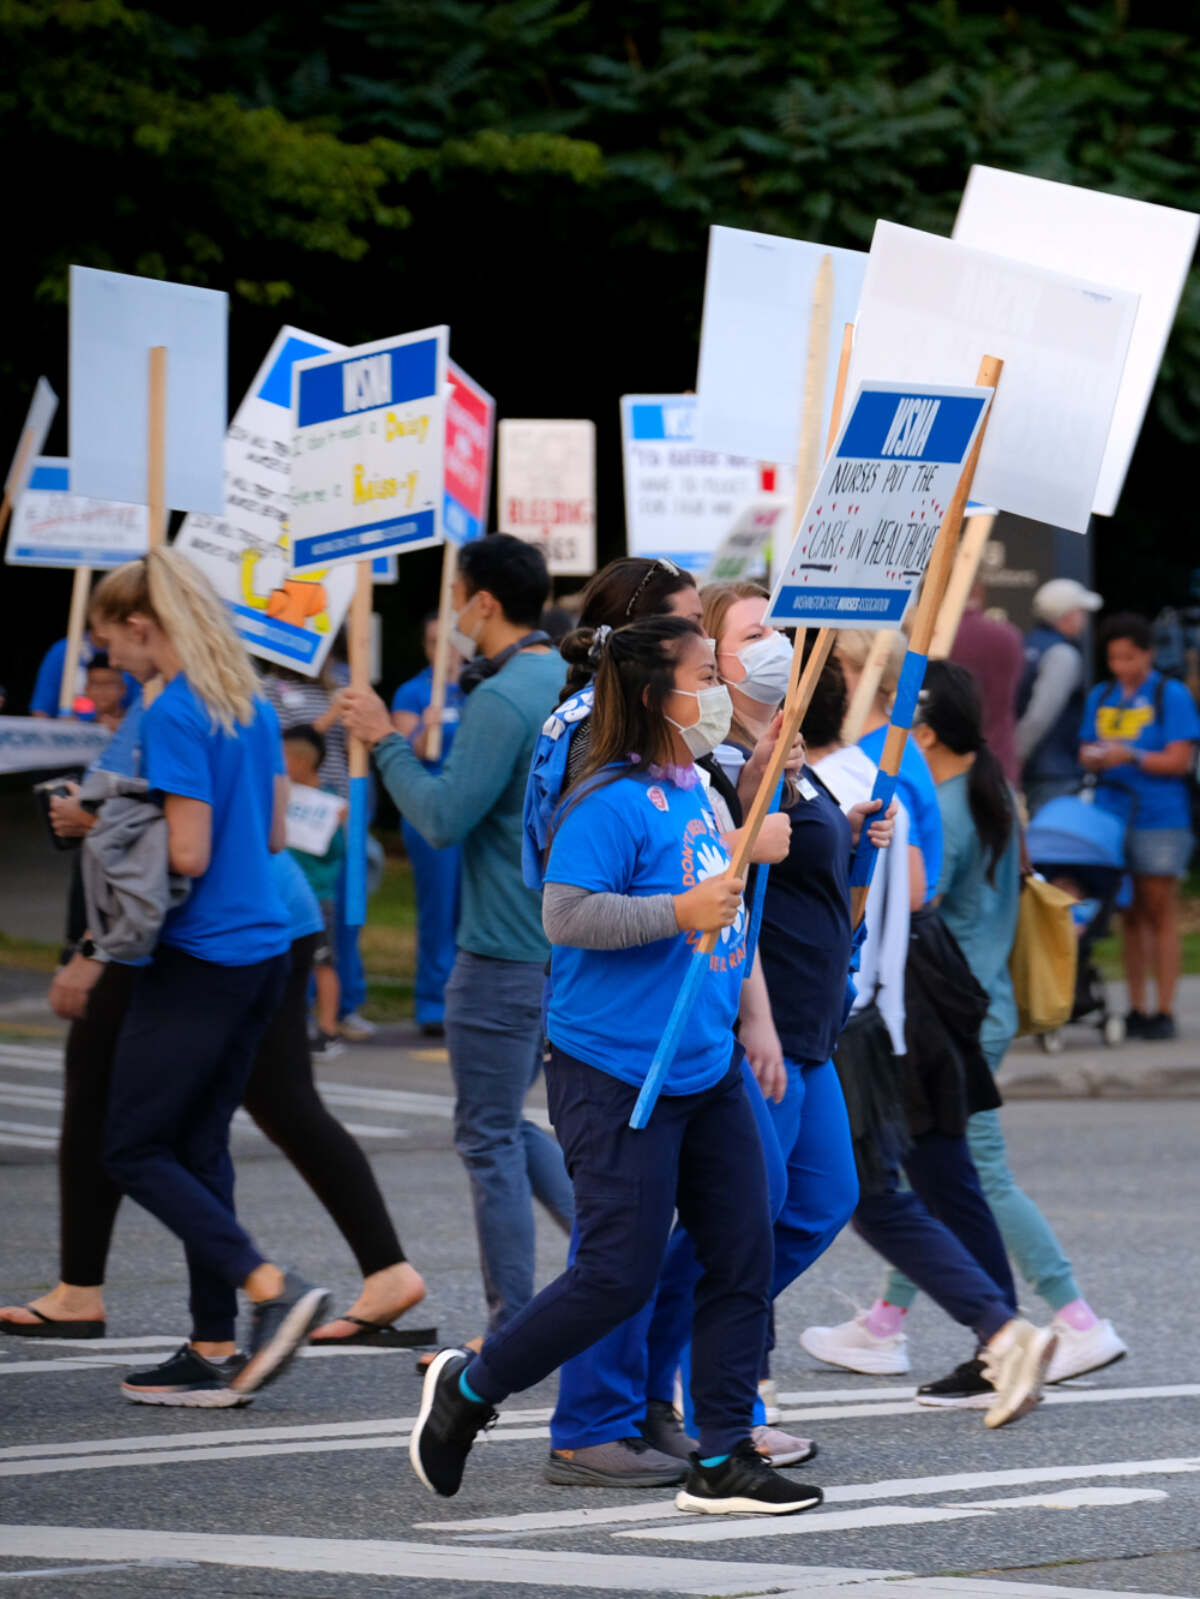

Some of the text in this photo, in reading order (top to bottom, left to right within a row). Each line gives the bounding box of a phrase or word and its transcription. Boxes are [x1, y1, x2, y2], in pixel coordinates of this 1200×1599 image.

[880, 397, 942, 458] WSNA
[828, 461, 940, 496] NURSES PUT THE
[808, 520, 850, 561] CARE
[847, 527, 869, 560] IN
